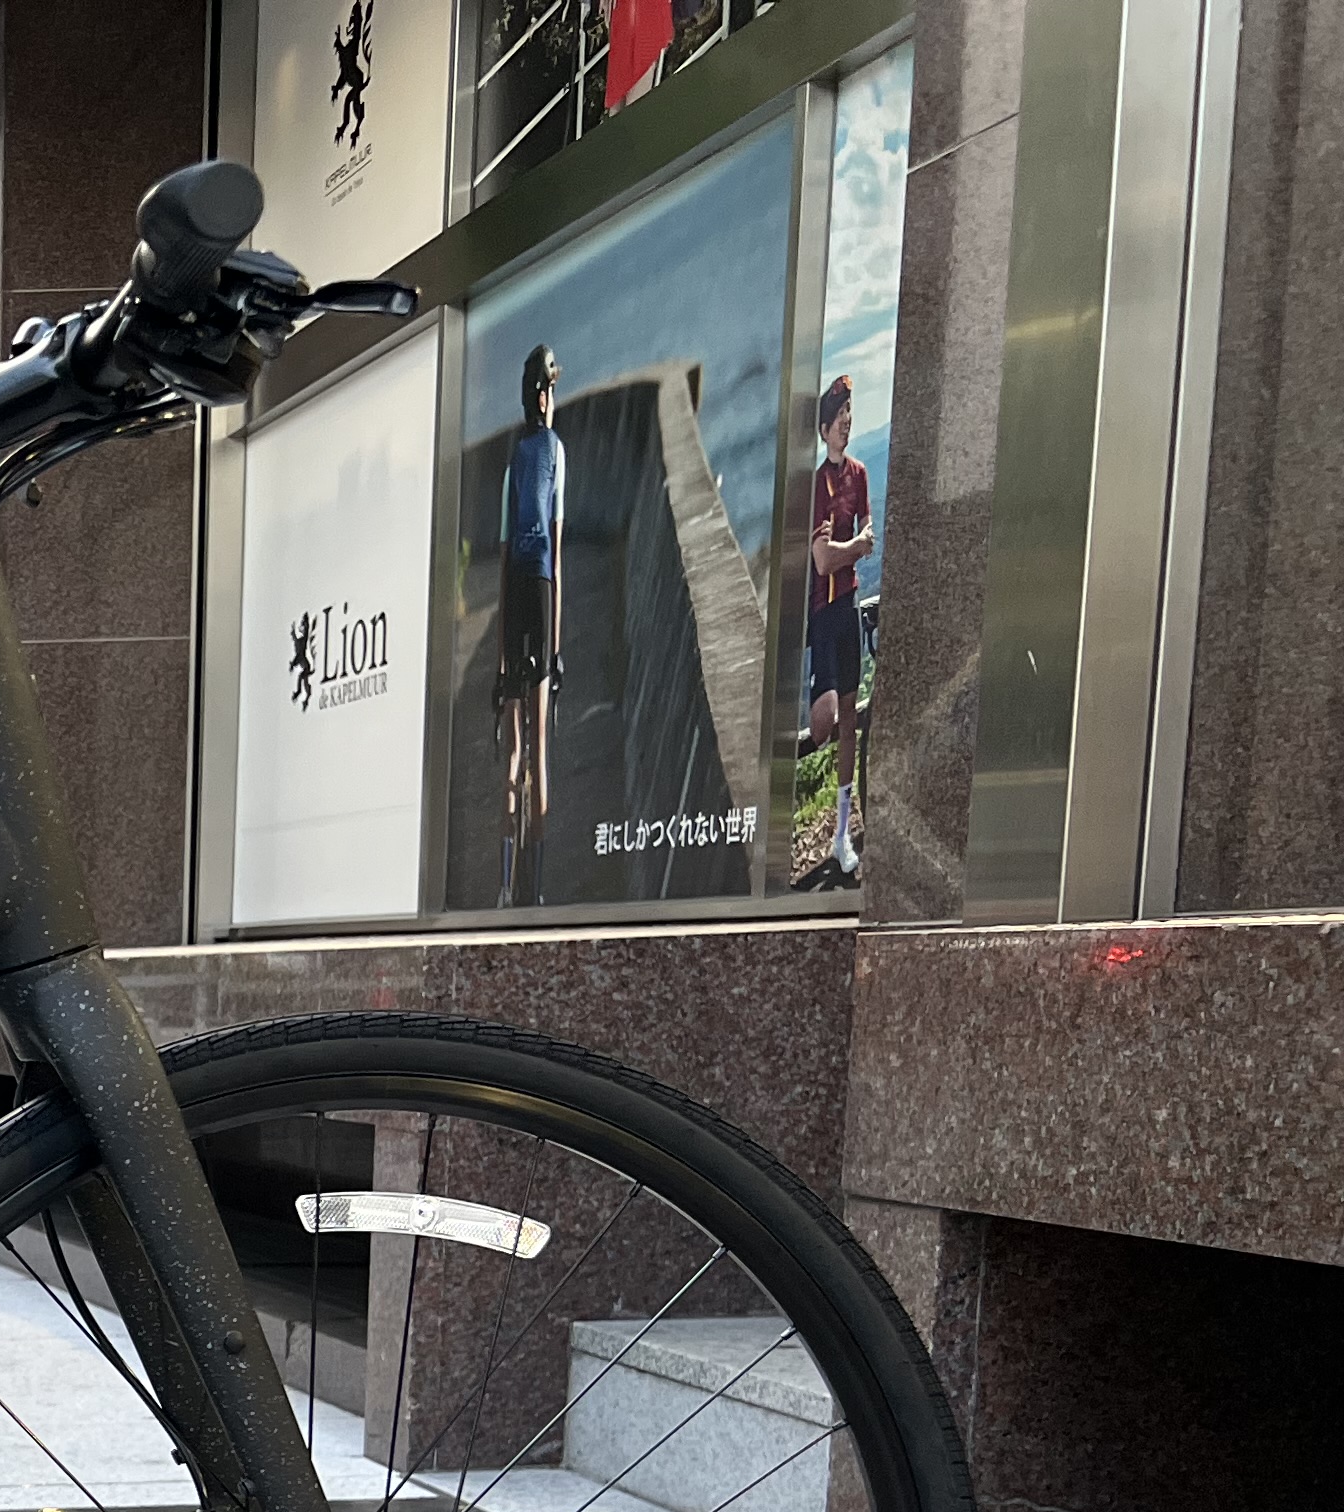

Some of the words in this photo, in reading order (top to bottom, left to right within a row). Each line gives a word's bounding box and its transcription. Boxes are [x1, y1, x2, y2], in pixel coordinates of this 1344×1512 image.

[320, 601, 388, 685] Lion
[329, 672, 388, 707] KAPELMUUR
[594, 806, 758, 856] 君にしかつくれない世界
